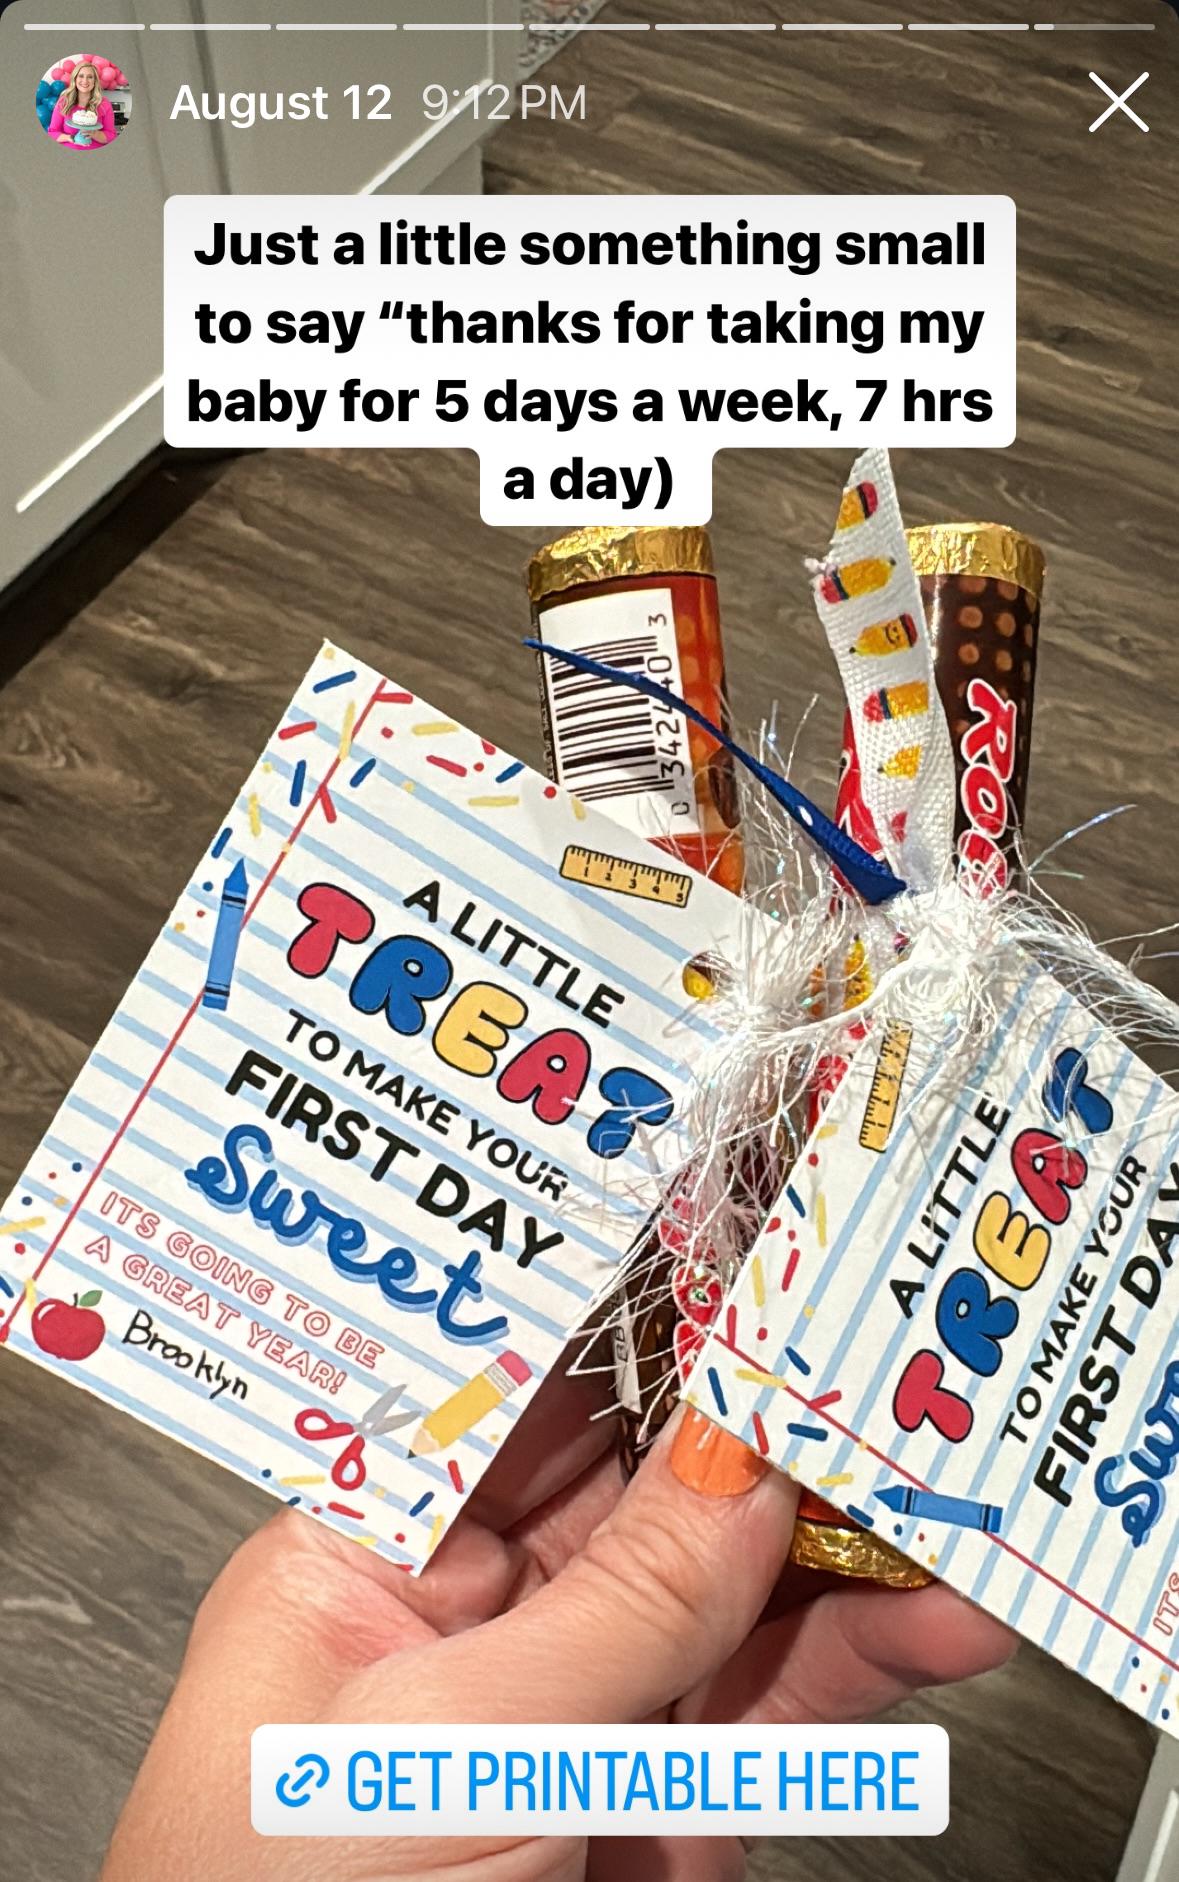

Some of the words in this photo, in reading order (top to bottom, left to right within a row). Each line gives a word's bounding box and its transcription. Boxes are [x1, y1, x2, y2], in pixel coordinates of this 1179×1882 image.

[648, 613, 667, 627] 3
[286, 881, 675, 1160] TREAT
[403, 880, 441, 924] A
[450, 901, 626, 1029] LITTLE
[225, 1048, 421, 1182] FIRST
[415, 1163, 565, 1269] DAY
[287, 1008, 342, 1063] TO
[343, 1049, 461, 1136] MAKE
[468, 1118, 569, 1202] YOUR
[889, 1279, 925, 1319] A
[907, 1092, 1012, 1269] LITTLE
[84, 1235, 113, 1264] A
[121, 1254, 245, 1330] GREAT
[245, 1322, 349, 1396] YEAR!
[100, 1190, 161, 1240] ITS
[165, 1230, 274, 1307] GOING
[284, 1295, 334, 1339] TO
[336, 1325, 386, 1371] BE
[183, 1124, 510, 1347] Sweet
[892, 1047, 1114, 1444] TREAT
[999, 1386, 1043, 1445] TO
[1030, 1262, 1099, 1384] MAKE
[1084, 1155, 1147, 1258] YOUR
[121, 1309, 249, 1400] Brooklyn
[1033, 1304, 1137, 1507] FIRST
